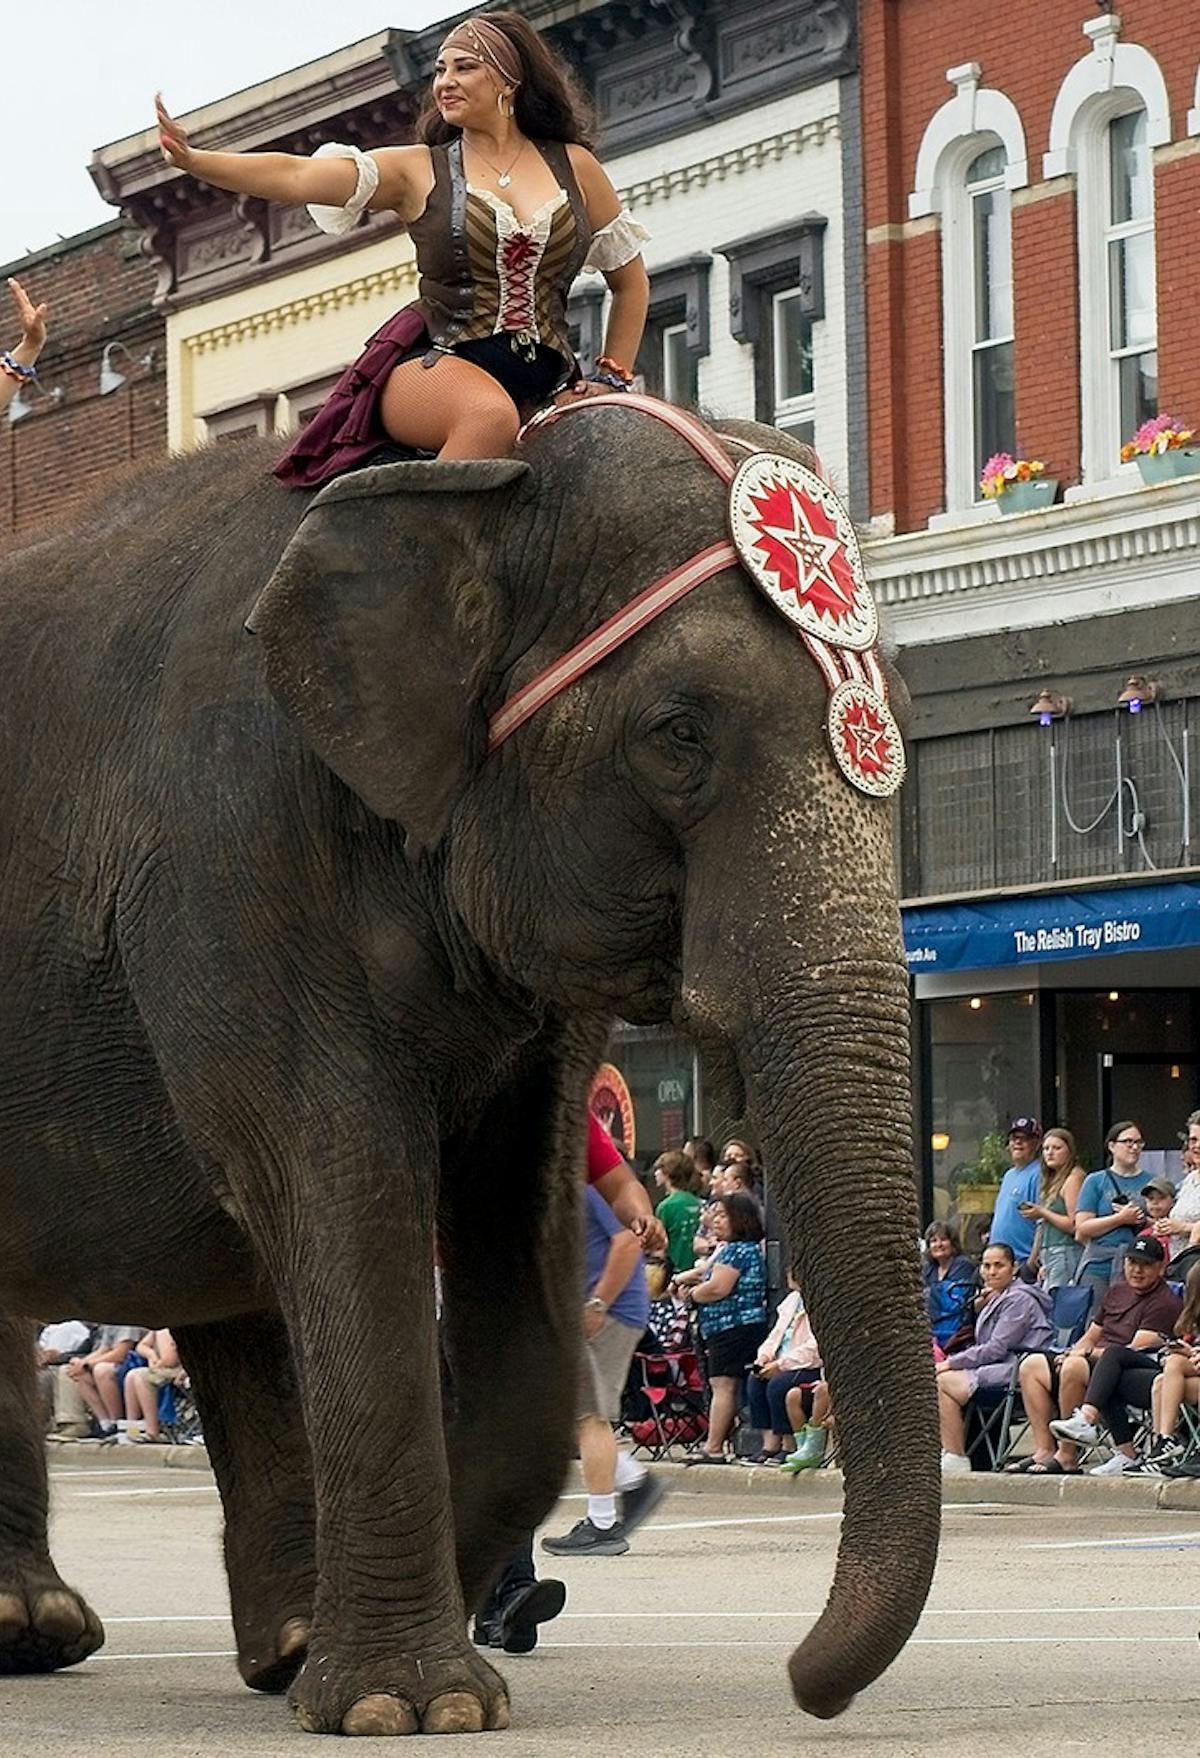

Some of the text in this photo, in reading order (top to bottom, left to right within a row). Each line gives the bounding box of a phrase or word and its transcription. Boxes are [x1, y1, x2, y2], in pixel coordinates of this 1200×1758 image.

[1013, 920, 1140, 953] The Relish Tray Bistro
[658, 1080, 684, 1102] OPEN
